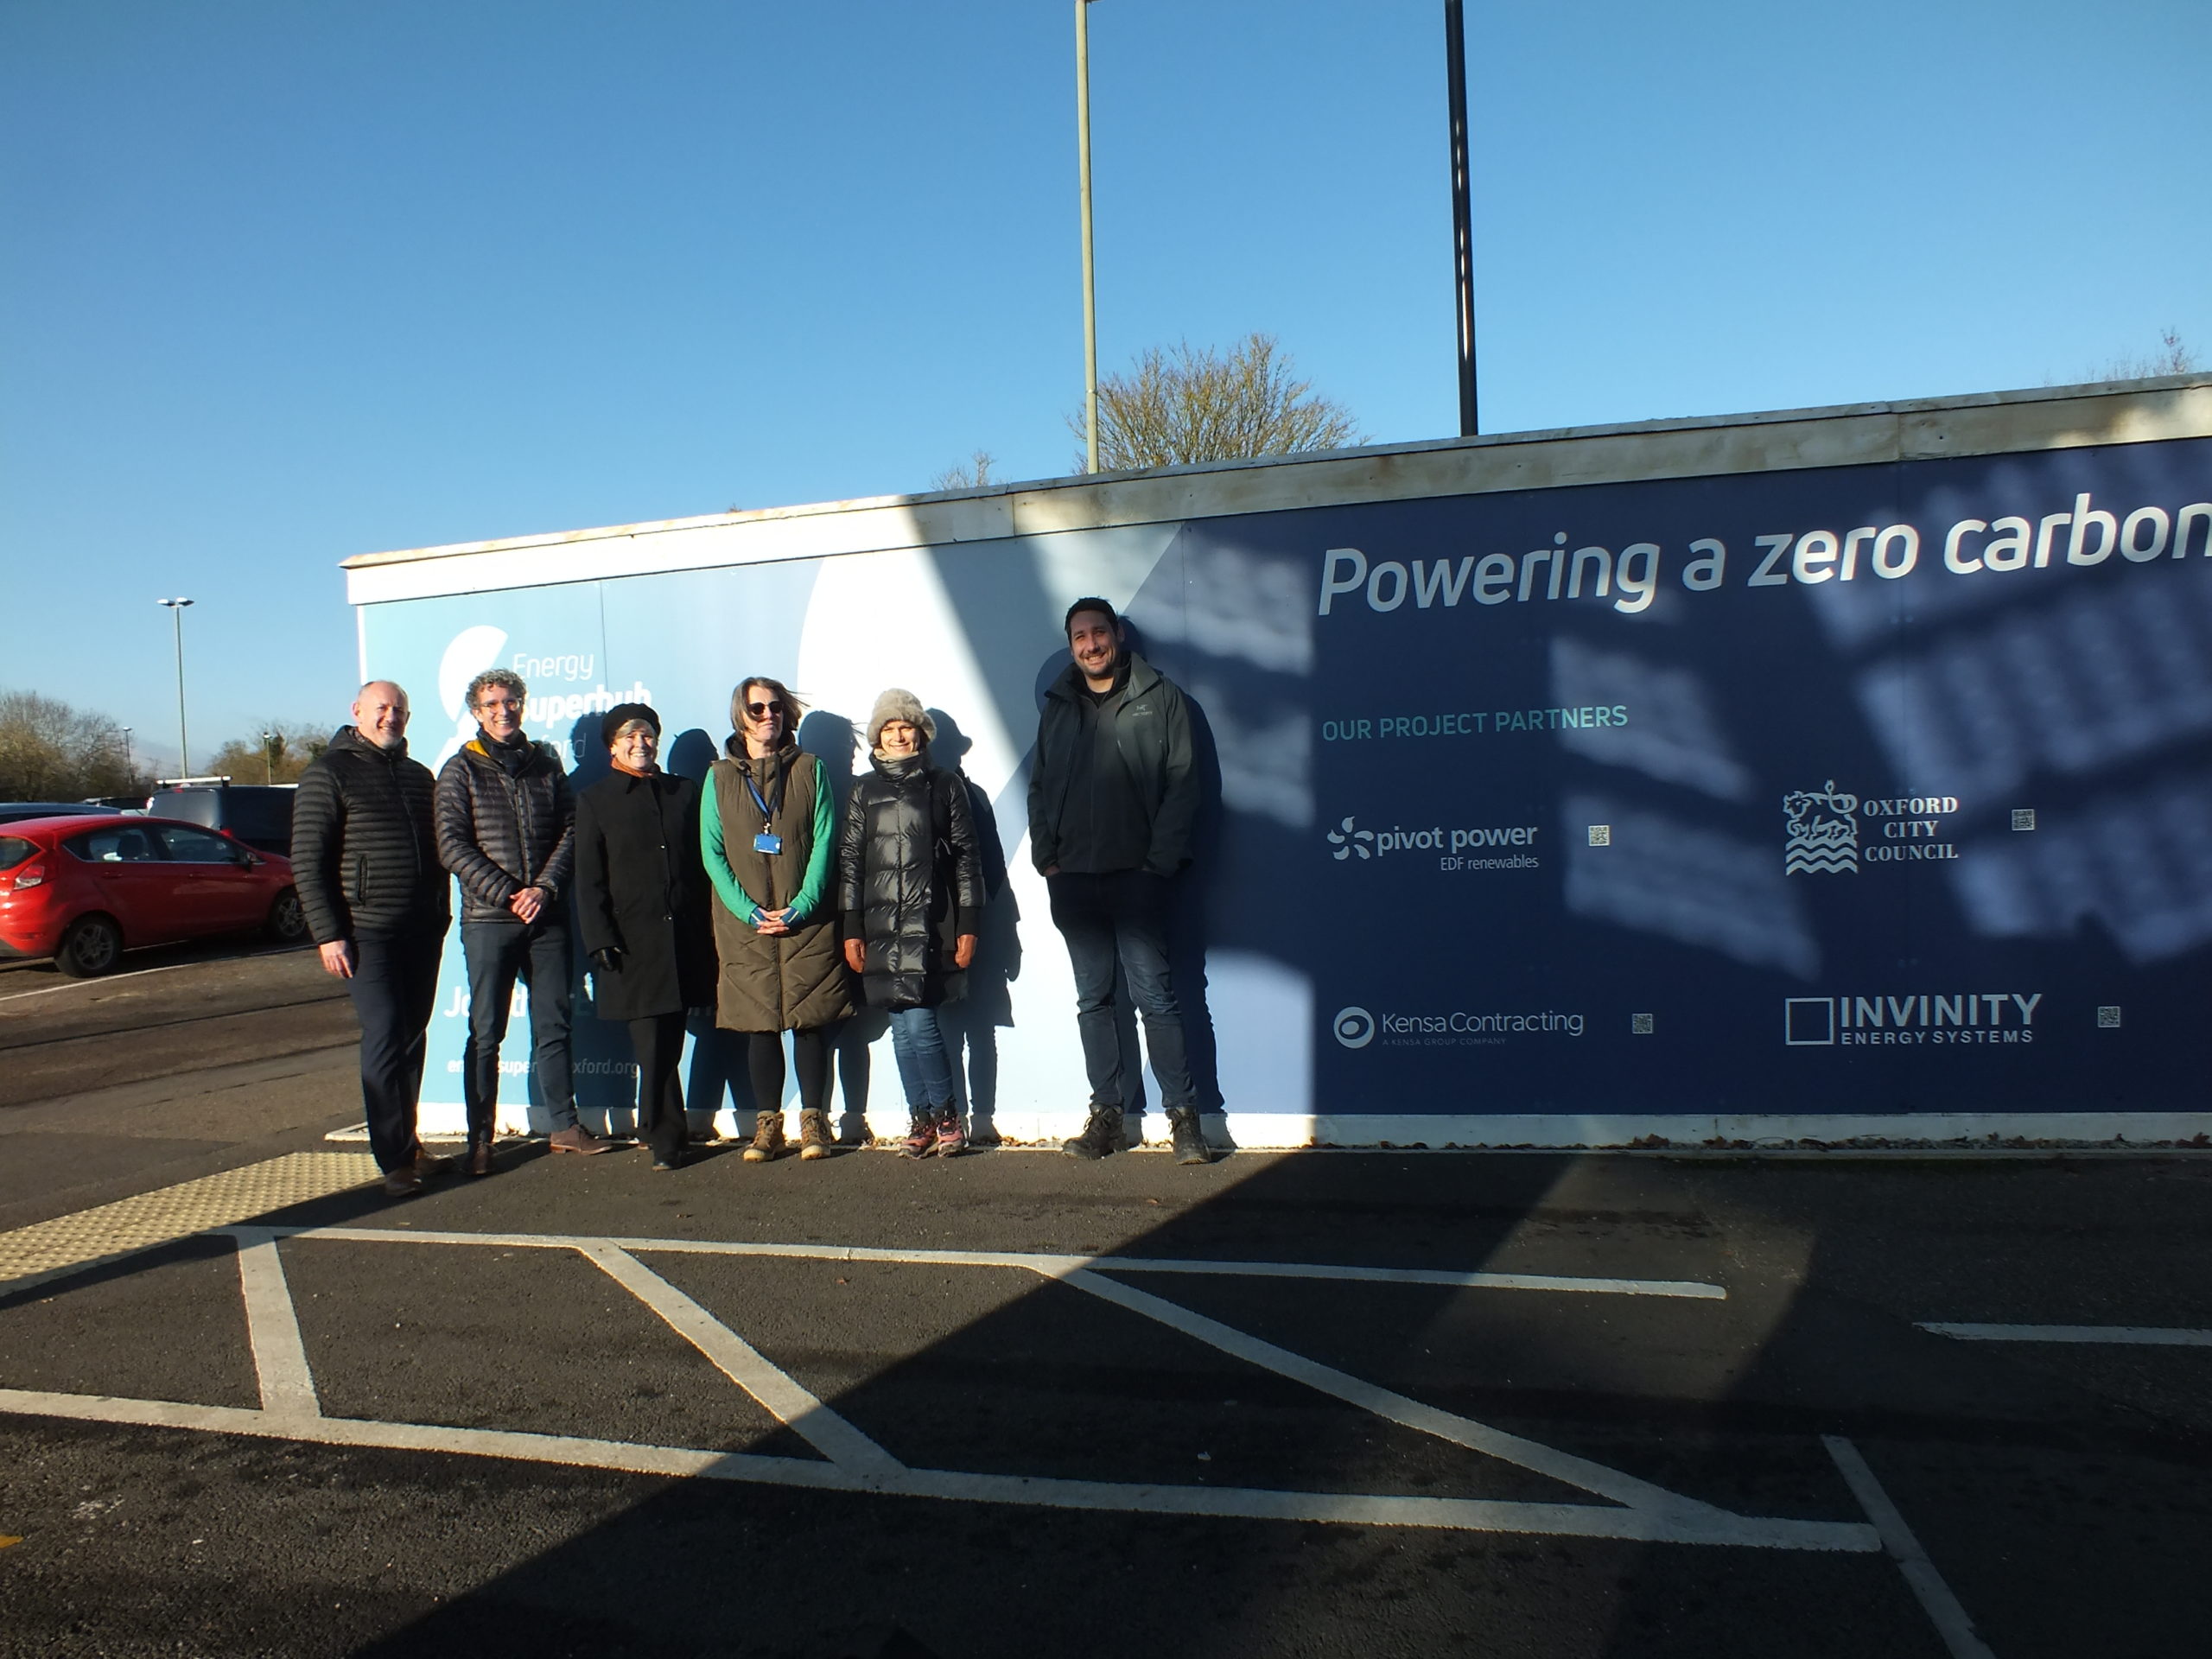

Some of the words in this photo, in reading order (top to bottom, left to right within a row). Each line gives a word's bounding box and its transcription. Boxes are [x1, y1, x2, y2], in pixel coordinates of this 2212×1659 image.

[1317, 531, 1660, 614] Powering
[1682, 537, 1726, 592] a
[1747, 523, 1919, 588] zero
[1943, 493, 2212, 575] carbon
[512, 653, 594, 682] Energy
[1322, 719, 1372, 741] OUR
[1379, 712, 1488, 739] PROJECT
[1495, 705, 1629, 732] PARTNERS
[1863, 796, 1959, 817] OXFORD
[1884, 820, 1939, 838] CITY
[1376, 827, 1444, 857] pivot
[1451, 826, 1538, 854] power
[1440, 856, 1465, 871] EDF
[1467, 854, 1540, 870] renewables
[1864, 843, 1959, 862] COUNCIL
[1840, 993, 2043, 1028] INVINITY
[1391, 1038, 1421, 1046] KENSA
[1423, 1037, 1457, 1046] GROUP
[1459, 1036, 1507, 1046] COMPANY
[1840, 1031, 1926, 1046] ENERGY
[1932, 1029, 2033, 1044] SYSTEMS
